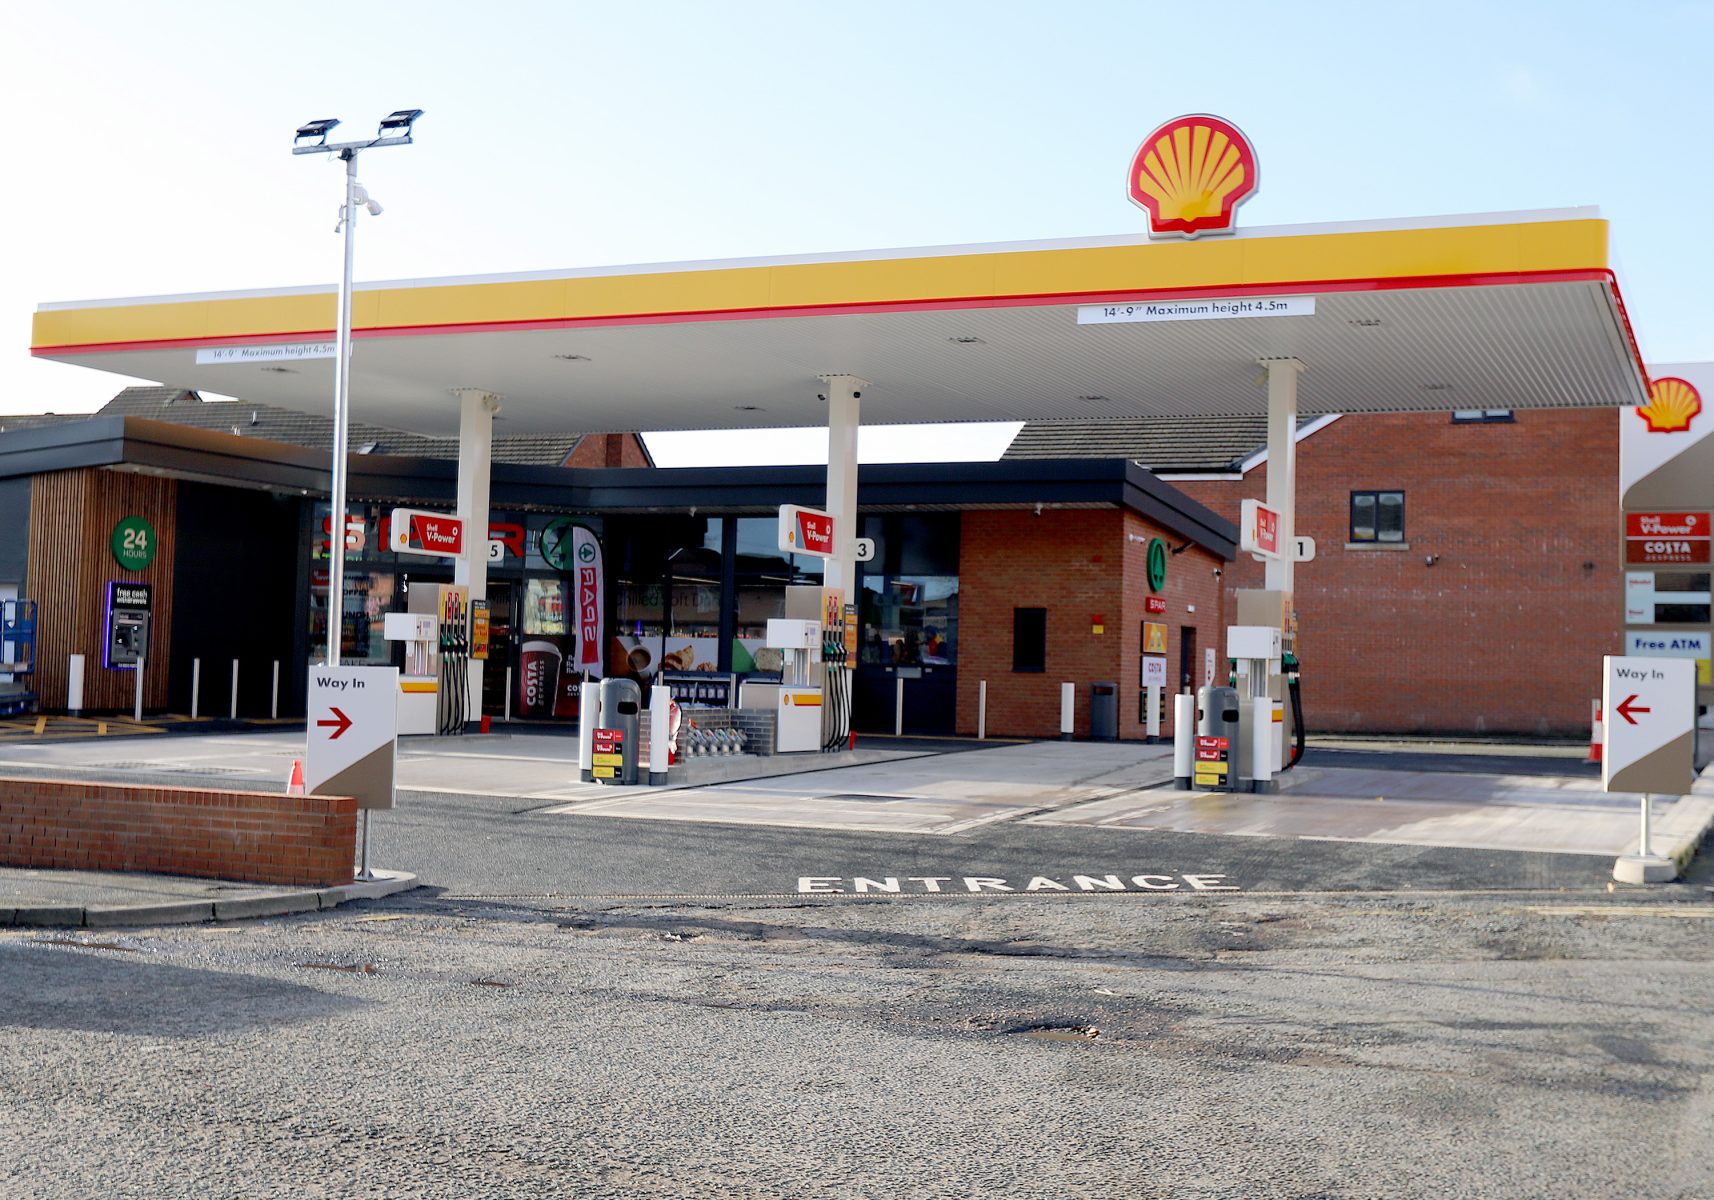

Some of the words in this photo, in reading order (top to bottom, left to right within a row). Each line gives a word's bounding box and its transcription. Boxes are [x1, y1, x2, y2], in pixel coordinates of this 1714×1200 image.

[1146, 304, 1208, 316] Maximum
[1212, 302, 1253, 315] height
[1255, 301, 1288, 311] 4.5m
[241, 348, 283, 357] Maximum
[284, 346, 312, 357] height
[313, 345, 335, 353] 4.5m
[426, 523, 438, 532] Shell
[123, 528, 147, 550] 24
[426, 531, 456, 544] V-Power
[123, 549, 147, 559] HOURS
[490, 545, 498, 557] 5
[857, 543, 867, 557] 3
[1297, 541, 1304, 556] 1
[1644, 541, 1692, 554] COSTA
[1150, 599, 1166, 610] SPAR
[1635, 638, 1666, 650] Free
[1670, 639, 1701, 650] ATM
[1617, 668, 1648, 682] Way
[1652, 669, 1665, 680] In
[317, 677, 348, 691] Way
[352, 678, 365, 688] In
[526, 660, 538, 706] COSTA
[797, 873, 1241, 893] ENTRANCE
